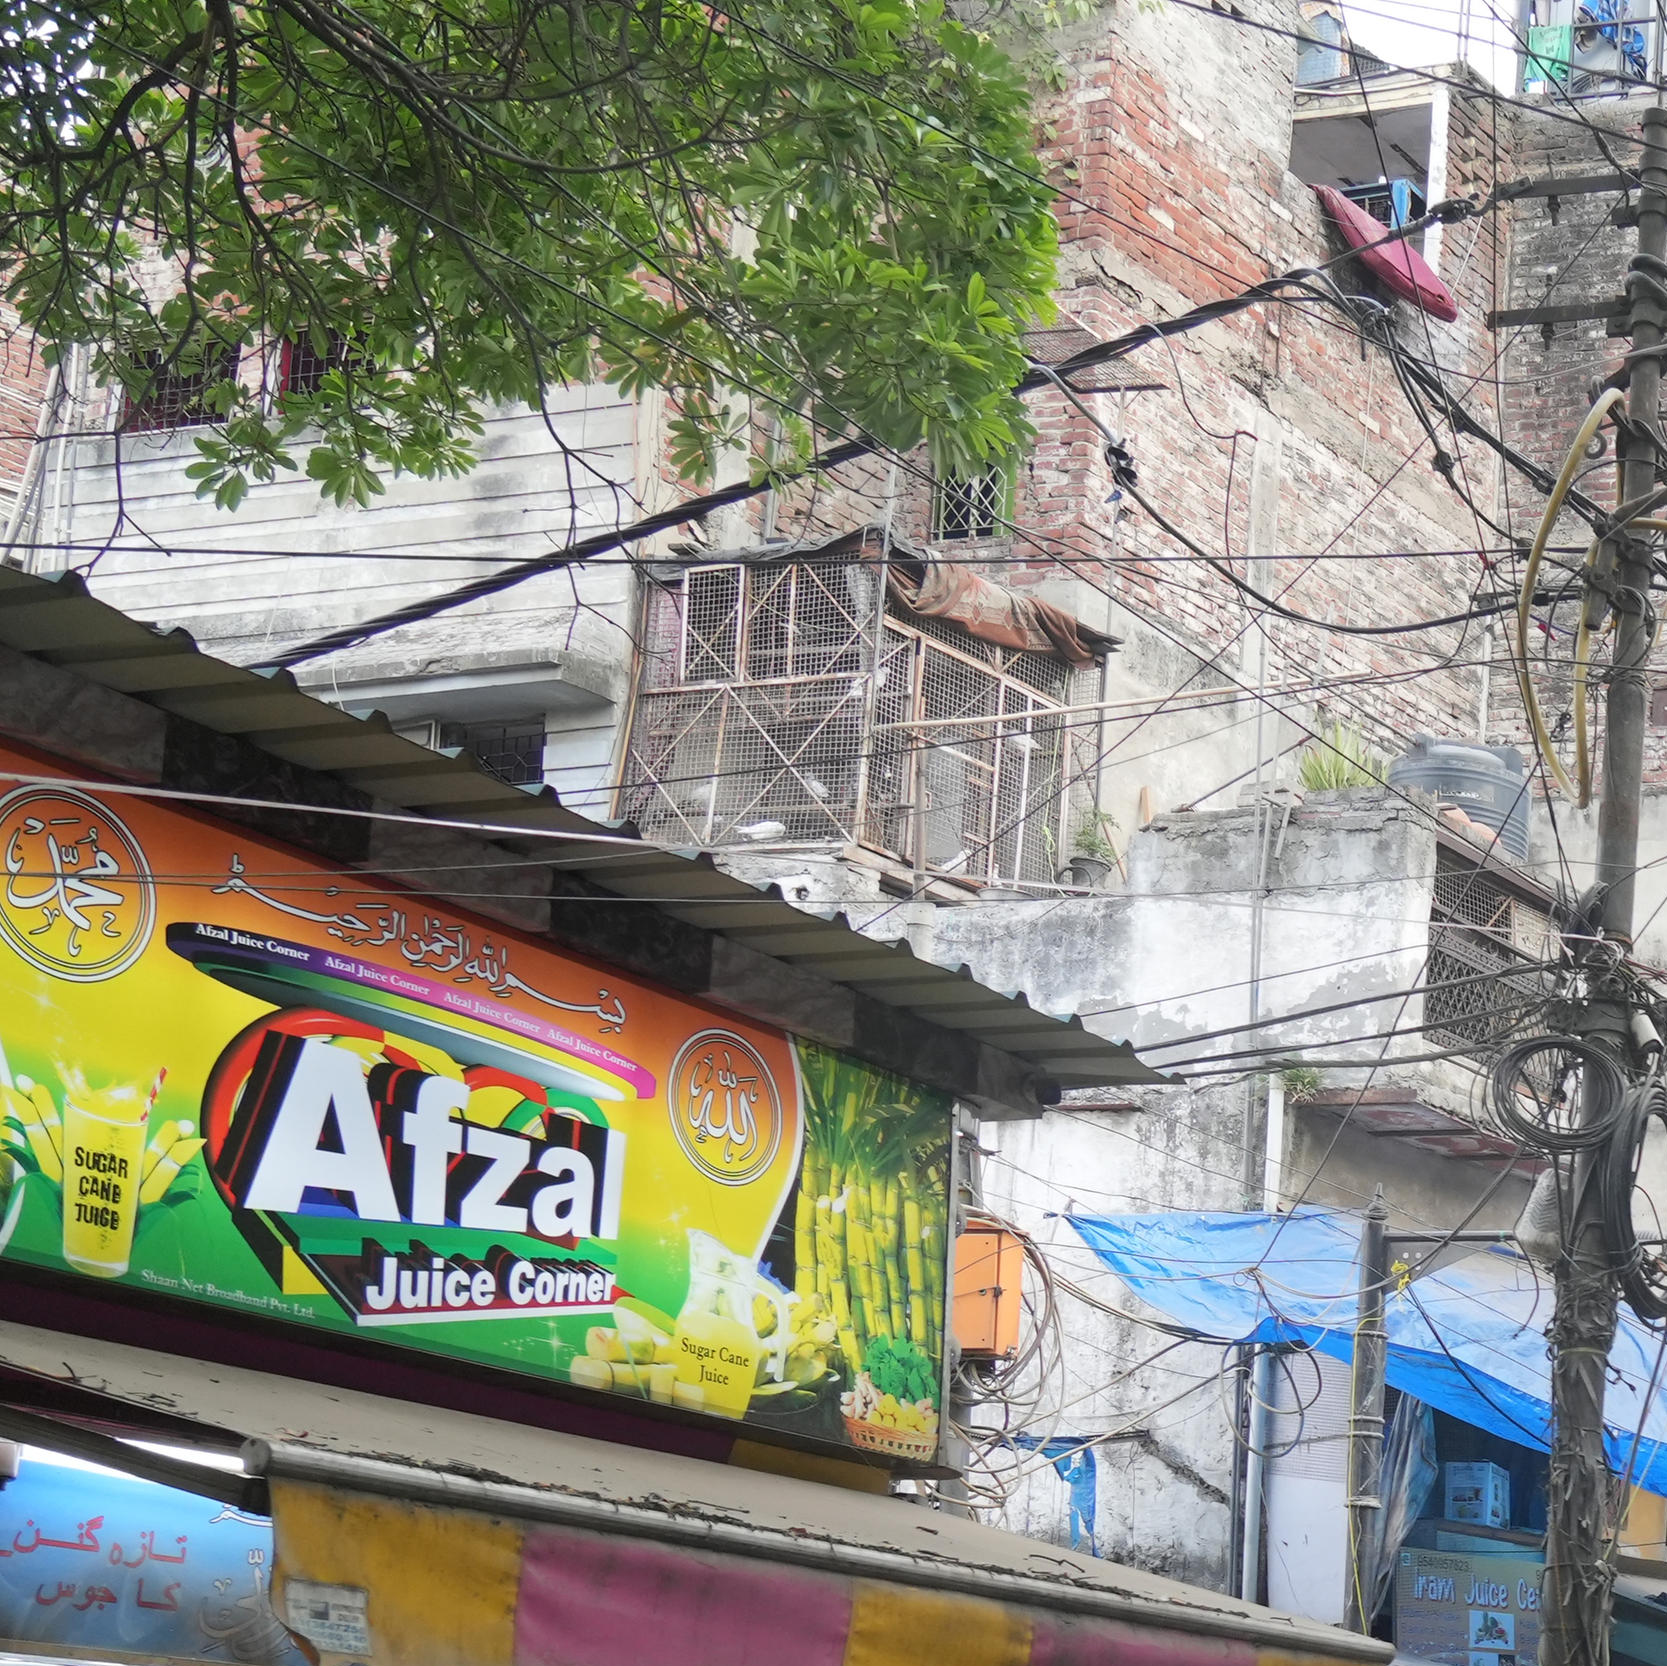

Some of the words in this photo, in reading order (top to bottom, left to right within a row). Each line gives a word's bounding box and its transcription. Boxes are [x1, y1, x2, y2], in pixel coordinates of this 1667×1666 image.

[195, 922, 229, 942] Afzal
[230, 931, 264, 951] Juice
[266, 938, 310, 963] Corner
[325, 956, 356, 975] Afzal
[357, 963, 388, 983] Juice
[390, 973, 430, 996] Corner
[244, 1036, 626, 1242] Afzal
[74, 1146, 129, 1179] SUGAR
[141, 1268, 178, 1289] Shaan
[205, 1282, 268, 1309] Broadband
[365, 1256, 497, 1314] Juice
[507, 1259, 618, 1306] Corner
[681, 1336, 717, 1363] Sugar
[718, 1345, 750, 1369] Cane
[699, 1364, 730, 1387] Juice
[1464, 1573, 1509, 1608] Juice
